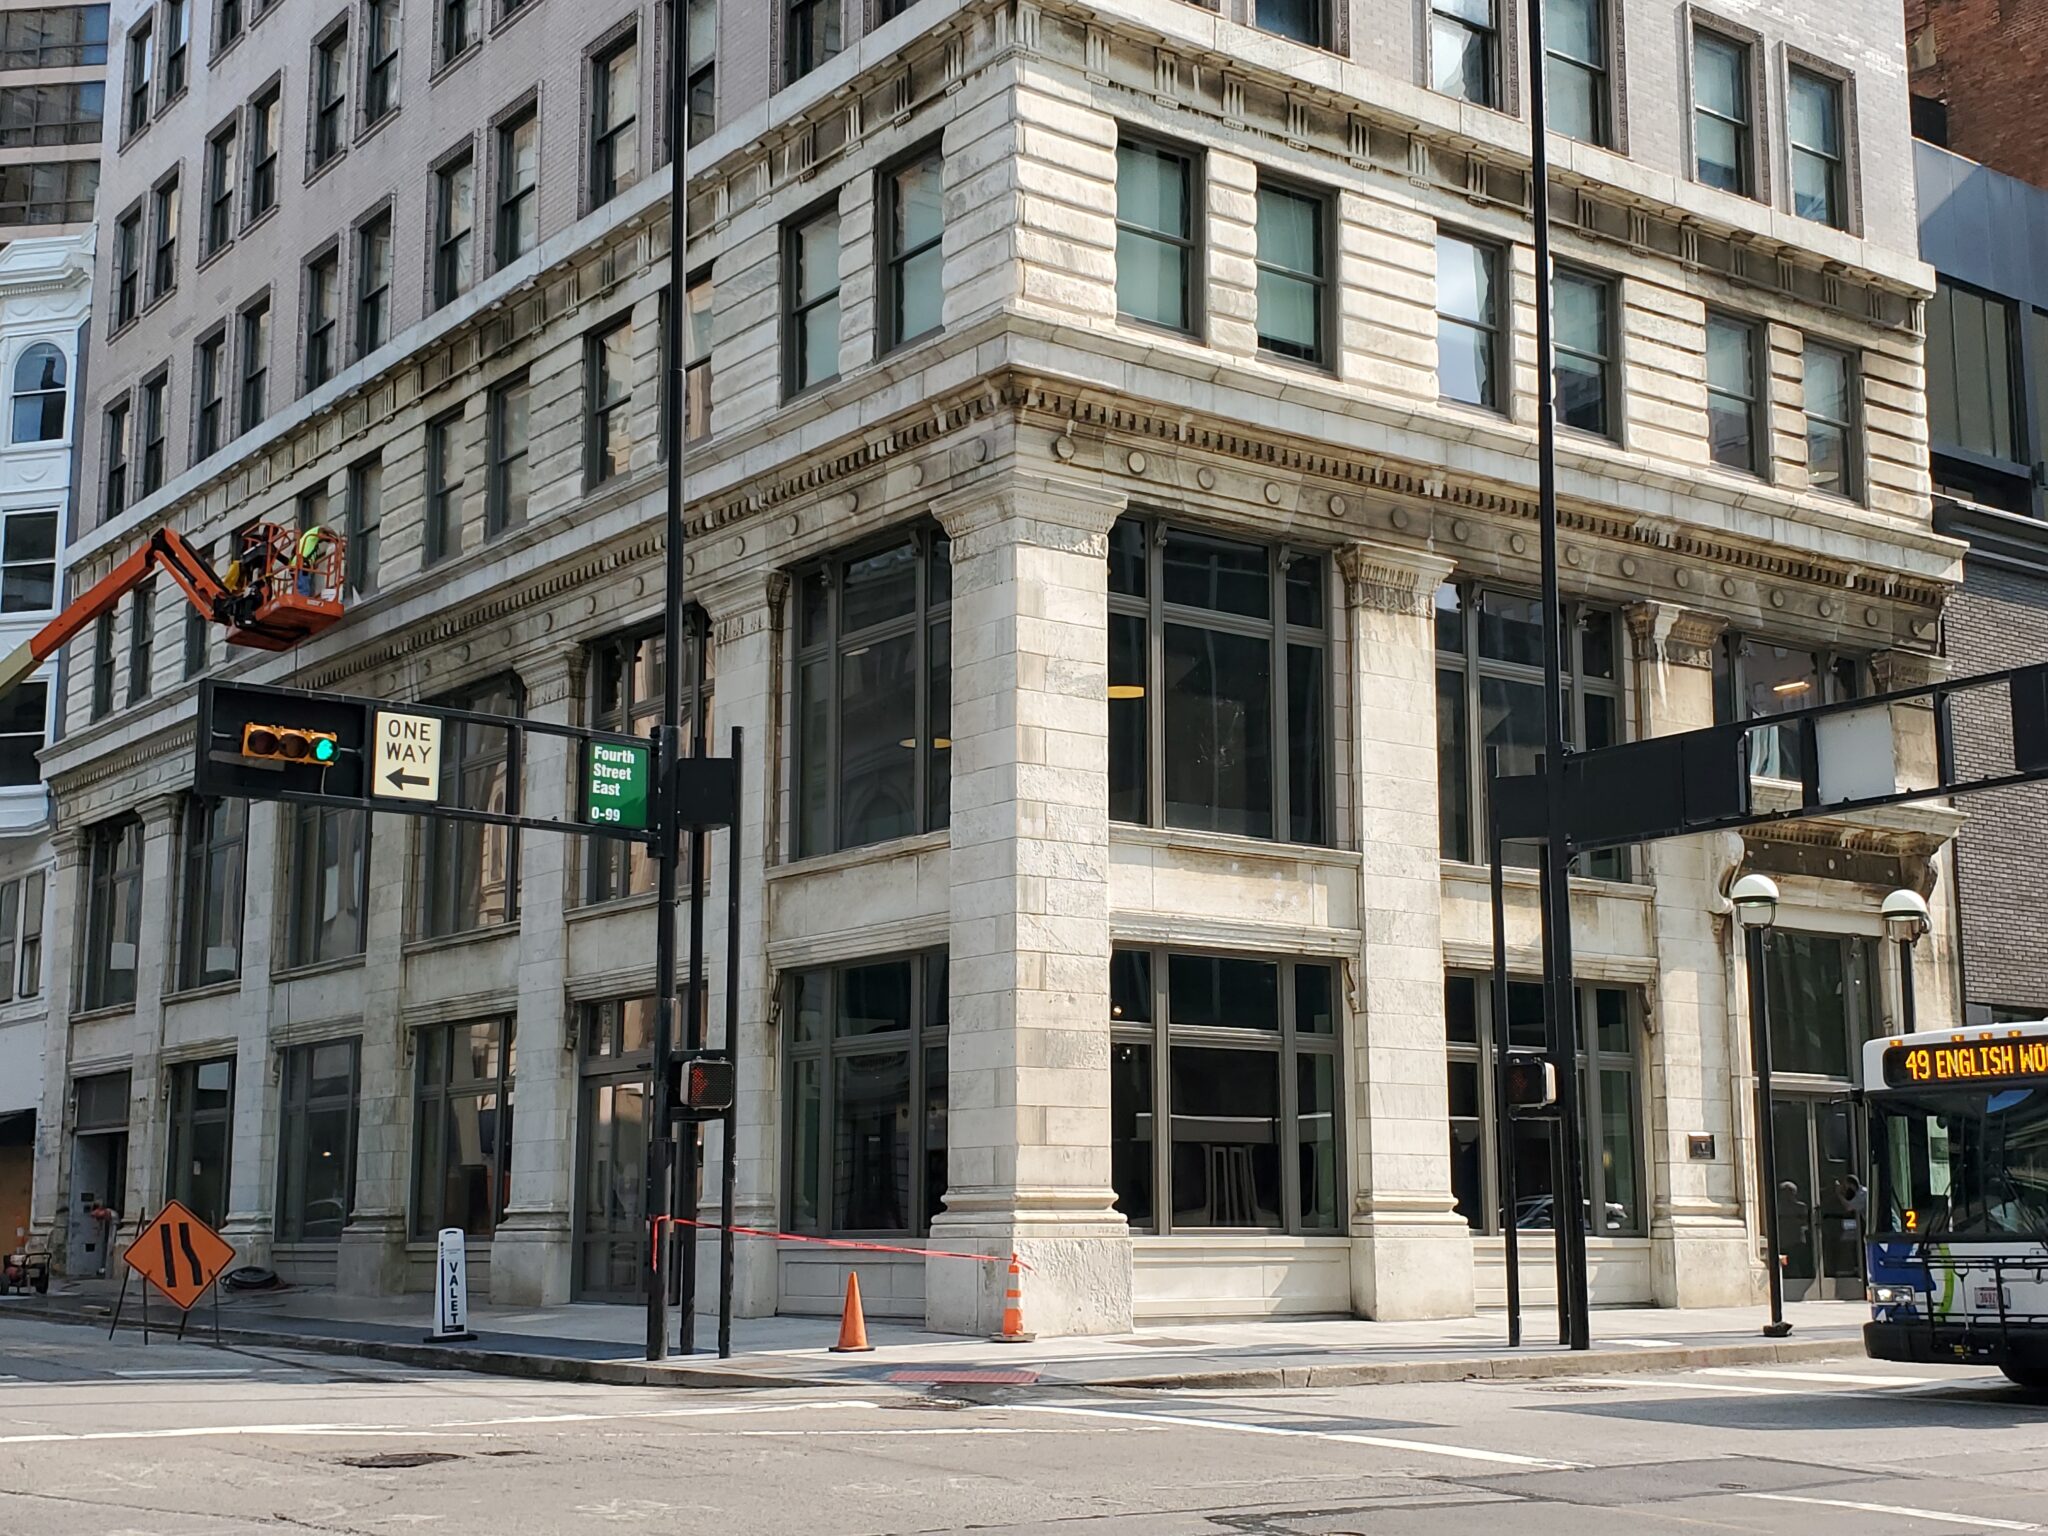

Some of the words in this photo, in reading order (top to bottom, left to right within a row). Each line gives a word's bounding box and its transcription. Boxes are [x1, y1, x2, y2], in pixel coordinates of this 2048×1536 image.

[388, 719, 431, 741] ONE
[386, 741, 432, 764] WAY
[594, 745, 635, 764] Fourth
[593, 763, 632, 780] Street
[592, 779, 620, 796] East
[591, 806, 621, 821] 0-99
[1905, 1050, 1931, 1080] 49
[1935, 1045, 2015, 1079] ENGLISH
[2019, 1043, 2048, 1073] WO
[1905, 1210, 1917, 1228] 2
[449, 1261, 459, 1324] VALET
